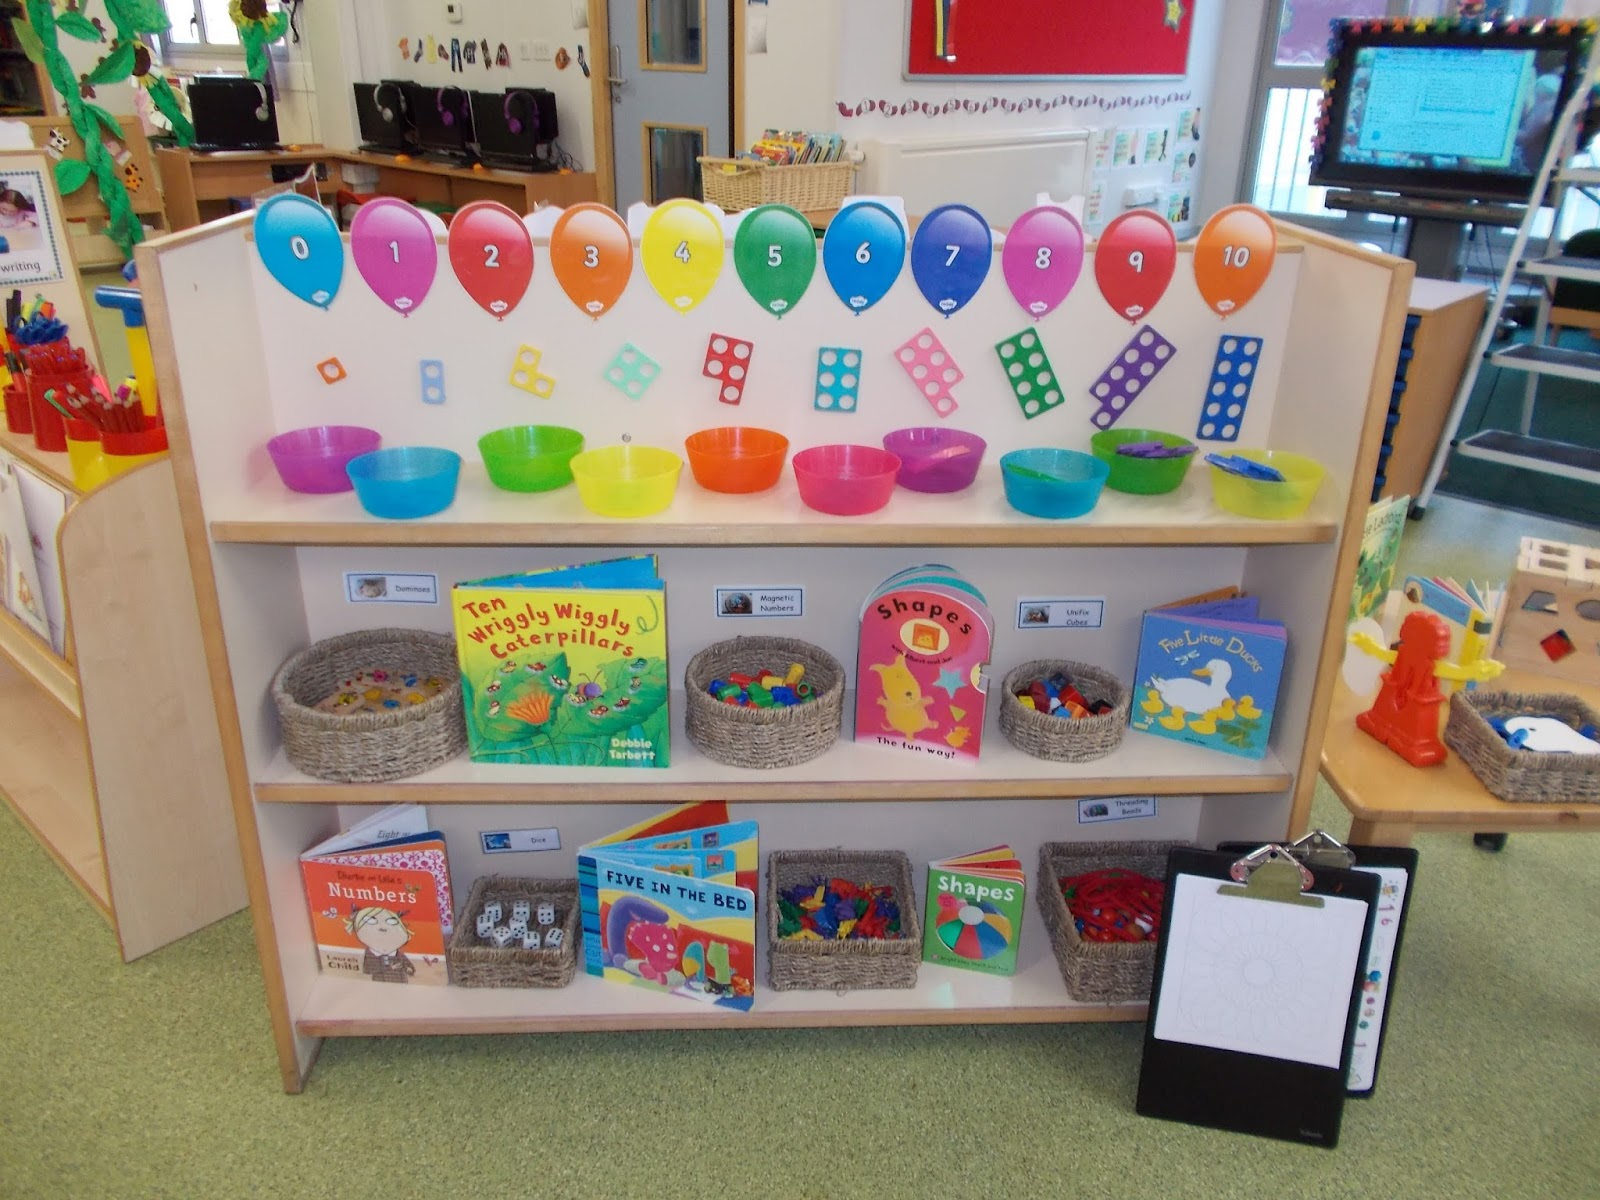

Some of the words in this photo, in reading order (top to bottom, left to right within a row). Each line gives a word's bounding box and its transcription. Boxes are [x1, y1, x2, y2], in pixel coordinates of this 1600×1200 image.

[291, 236, 310, 260] 0
[389, 240, 401, 263] 1
[484, 244, 500, 268] 2
[583, 244, 600, 268] 3
[674, 241, 691, 264] 4
[767, 244, 783, 267] 5
[855, 241, 871, 264] 6
[945, 245, 961, 267] 7
[1035, 246, 1052, 270] 8
[1223, 244, 1250, 269] 10
[0, 261, 41, 273] writing
[1128, 250, 1144, 273] 9
[395, 585, 431, 593] Dominoes
[760, 595, 795, 603] Magnetic
[462, 597, 507, 619] Ten
[877, 598, 972, 635] Shapes
[467, 603, 550, 644] Wriggly
[553, 602, 630, 636] Wiggly
[489, 628, 634, 660] Caterpillars
[1158, 637, 1185, 654] Five
[1184, 630, 1224, 647] Little
[1225, 636, 1264, 673] Ducks
[611, 738, 652, 749] Debbie
[876, 736, 898, 747] The
[902, 742, 922, 752] fun
[926, 748, 956, 759] way!
[609, 750, 656, 761] Tarbett
[1115, 799, 1149, 807] Threading
[377, 830, 400, 840] Eight
[327, 882, 417, 904] Numbers
[606, 870, 644, 890] FIVE
[651, 881, 671, 895] IN
[677, 886, 706, 903] THE
[714, 893, 747, 912] BED
[326, 954, 359, 963] Lauren
[328, 960, 360, 972] Child
